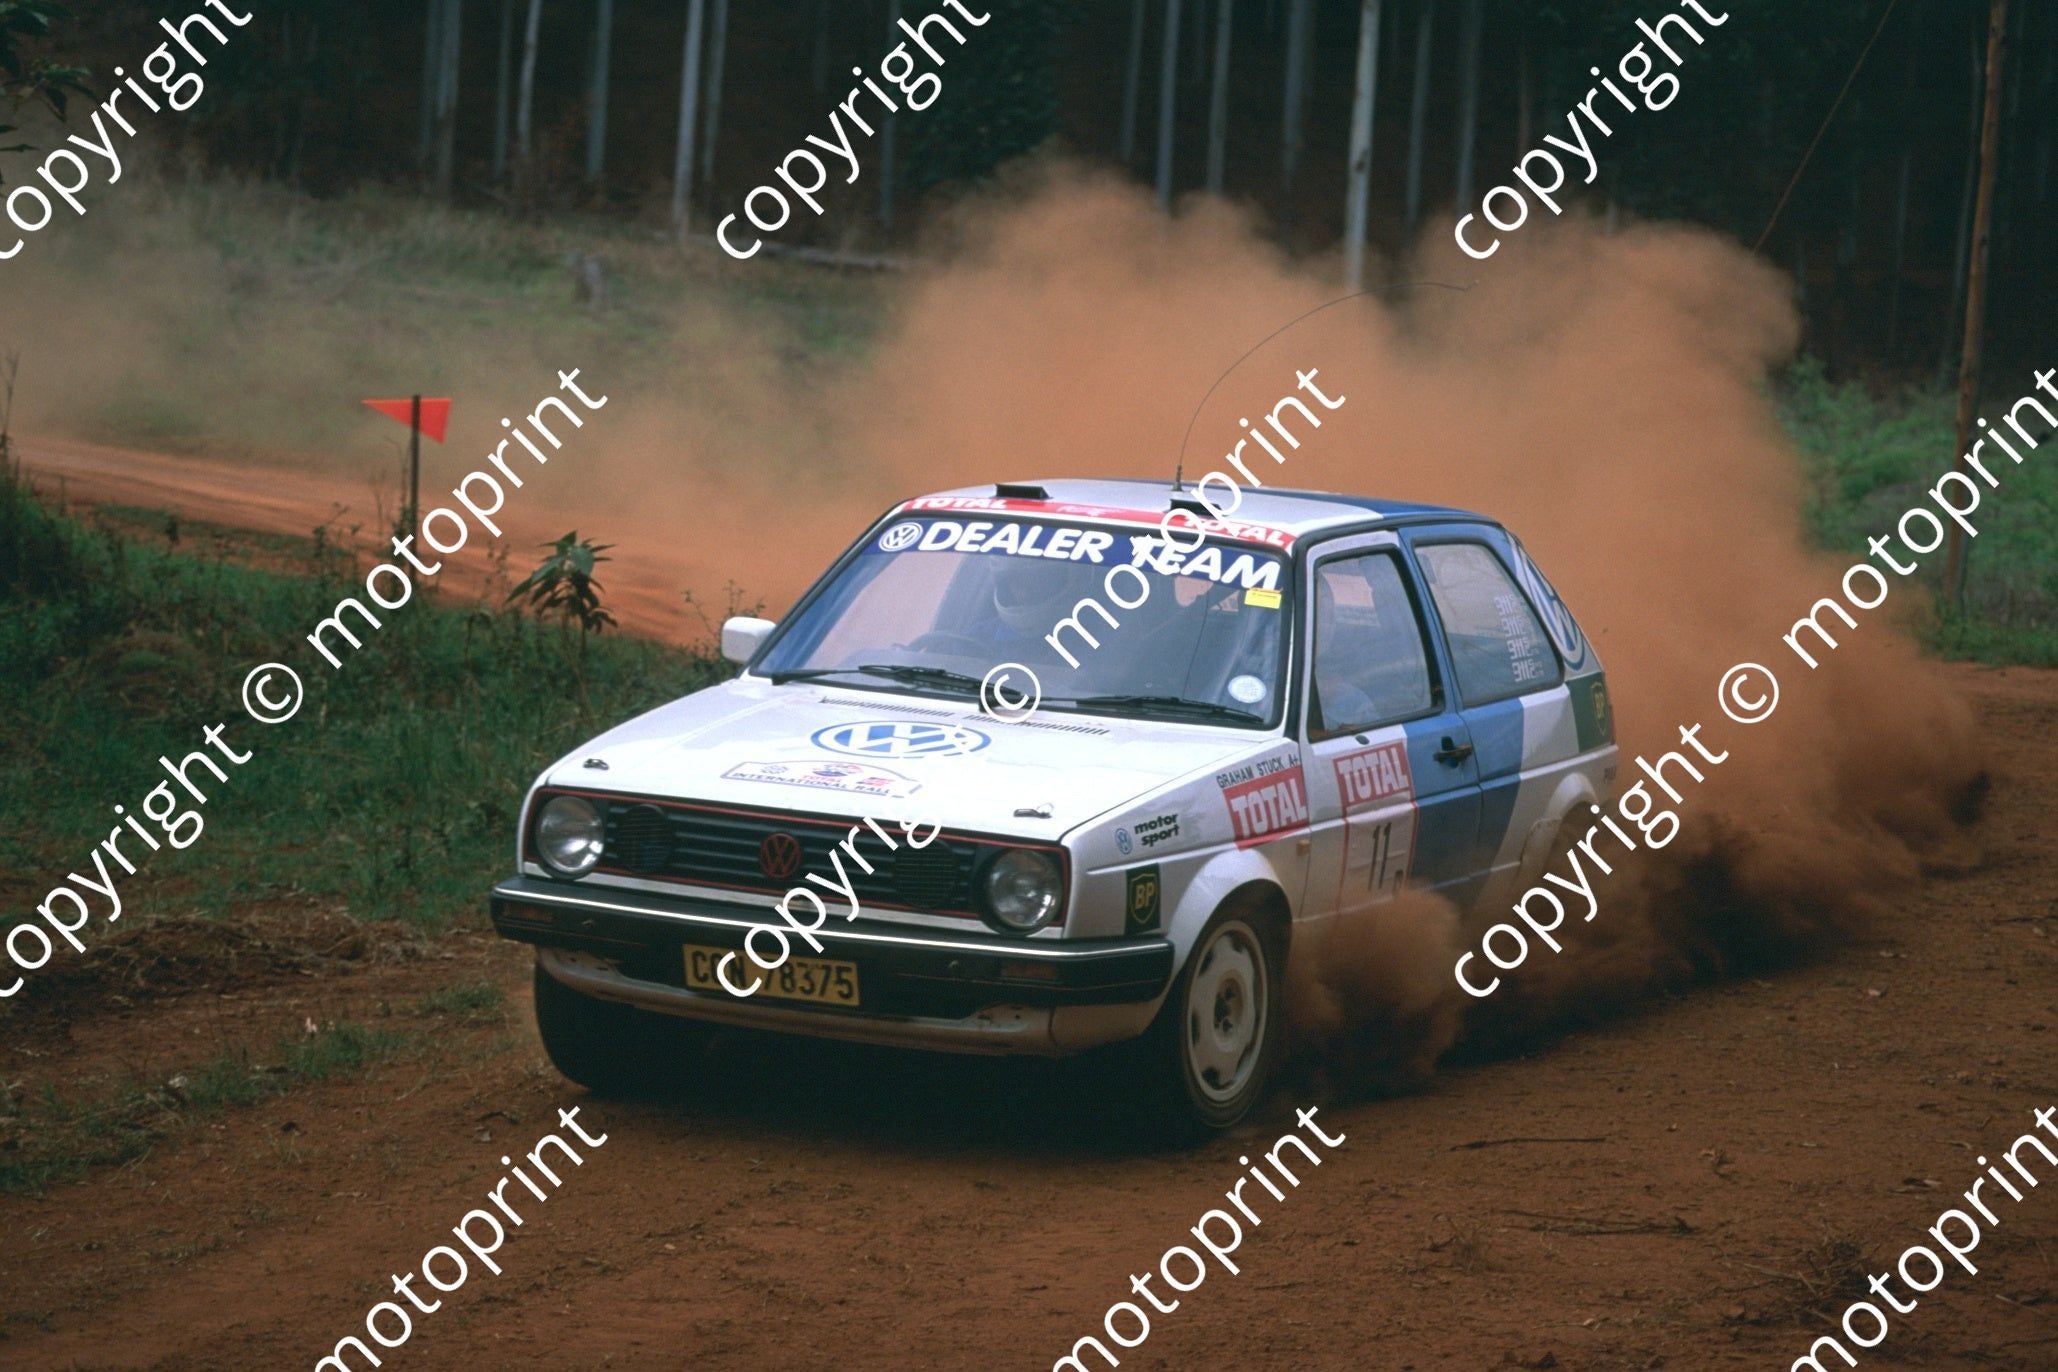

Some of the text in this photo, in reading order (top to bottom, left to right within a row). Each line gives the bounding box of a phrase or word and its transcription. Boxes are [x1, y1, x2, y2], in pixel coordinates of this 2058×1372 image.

[911, 497, 1008, 510] TOTAL
[917, 521, 1114, 563] DEALER
[1133, 536, 1281, 592] TEAM
[731, 771, 892, 794] INTERNATIONAL RALL
[1215, 764, 1254, 789] GRAHAM
[1256, 755, 1285, 777] STUCK
[1336, 745, 1409, 803] TOTAL
[1134, 812, 1179, 836] motor
[1230, 777, 1307, 839] TOTAL
[1140, 823, 1180, 848] sport
[1367, 821, 1392, 892] 11
[1134, 880, 1156, 911] BP
[762, 959, 854, 1000] 78375
